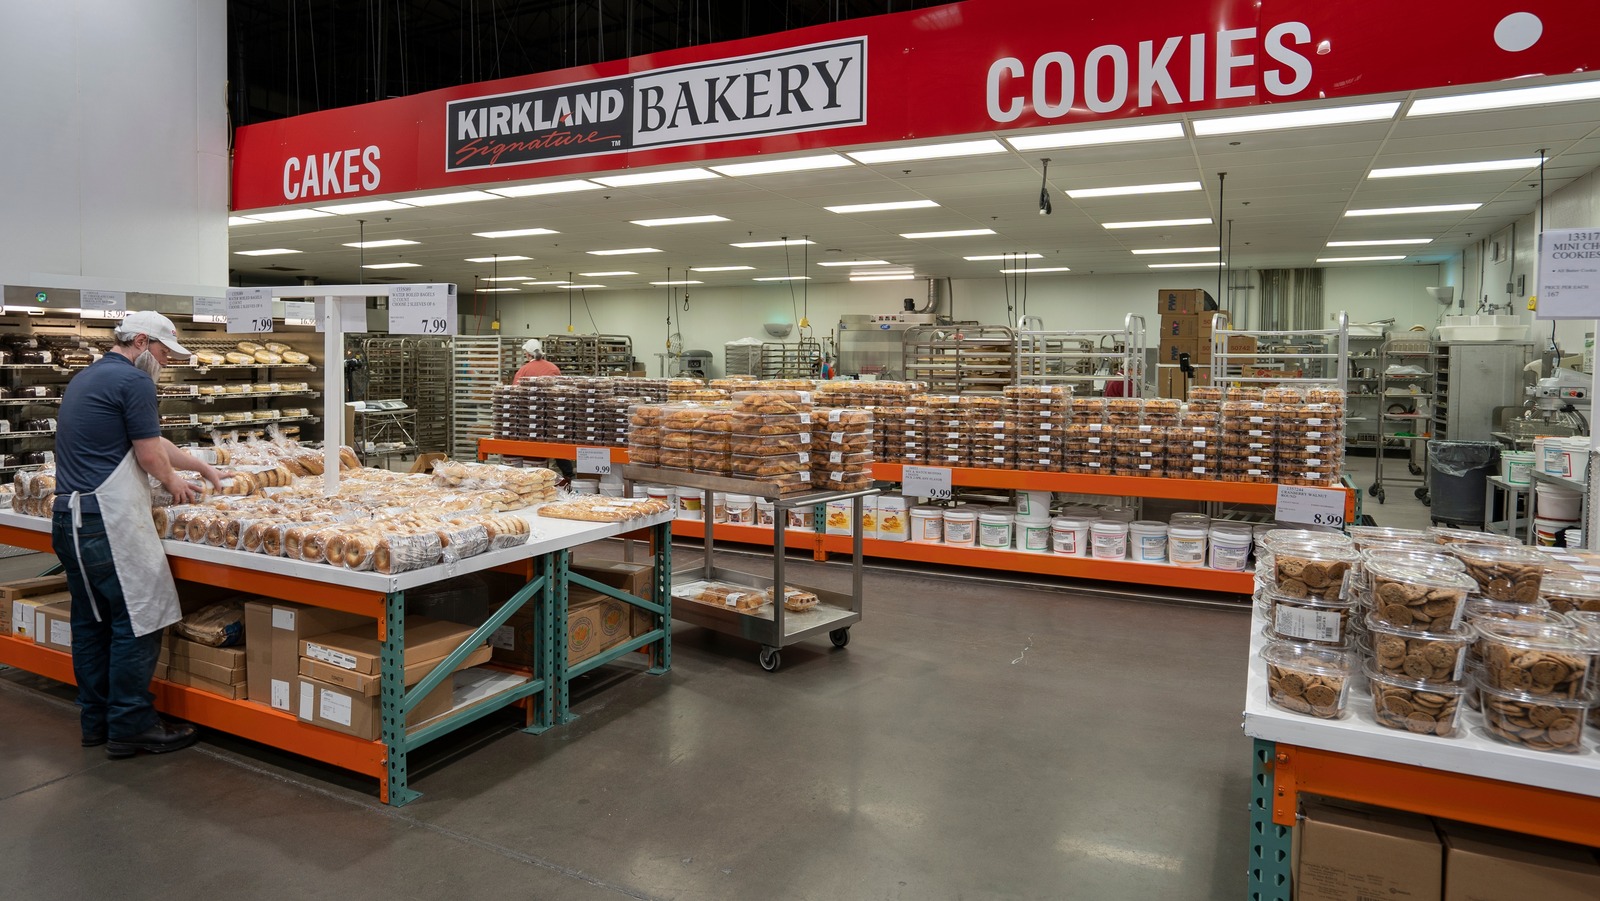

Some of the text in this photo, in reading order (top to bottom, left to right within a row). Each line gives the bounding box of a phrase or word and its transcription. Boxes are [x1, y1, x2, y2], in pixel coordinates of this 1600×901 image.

[986, 21, 1312, 123] COOKIES
[637, 56, 853, 134] BAKERY
[457, 89, 625, 141] KIRKLAND
[455, 129, 621, 166] Signature
[283, 144, 381, 200] CAKES
[1553, 242, 1600, 251] MINI CH
[1552, 251, 1600, 259] COOKIES
[103, 310, 126, 318] 15.99
[252, 319, 272, 331] 7.99
[421, 319, 447, 333] 7.99
[595, 465, 610, 473] 9.99
[930, 488, 951, 498] 9.99
[1313, 513, 1343, 526] 8.99
